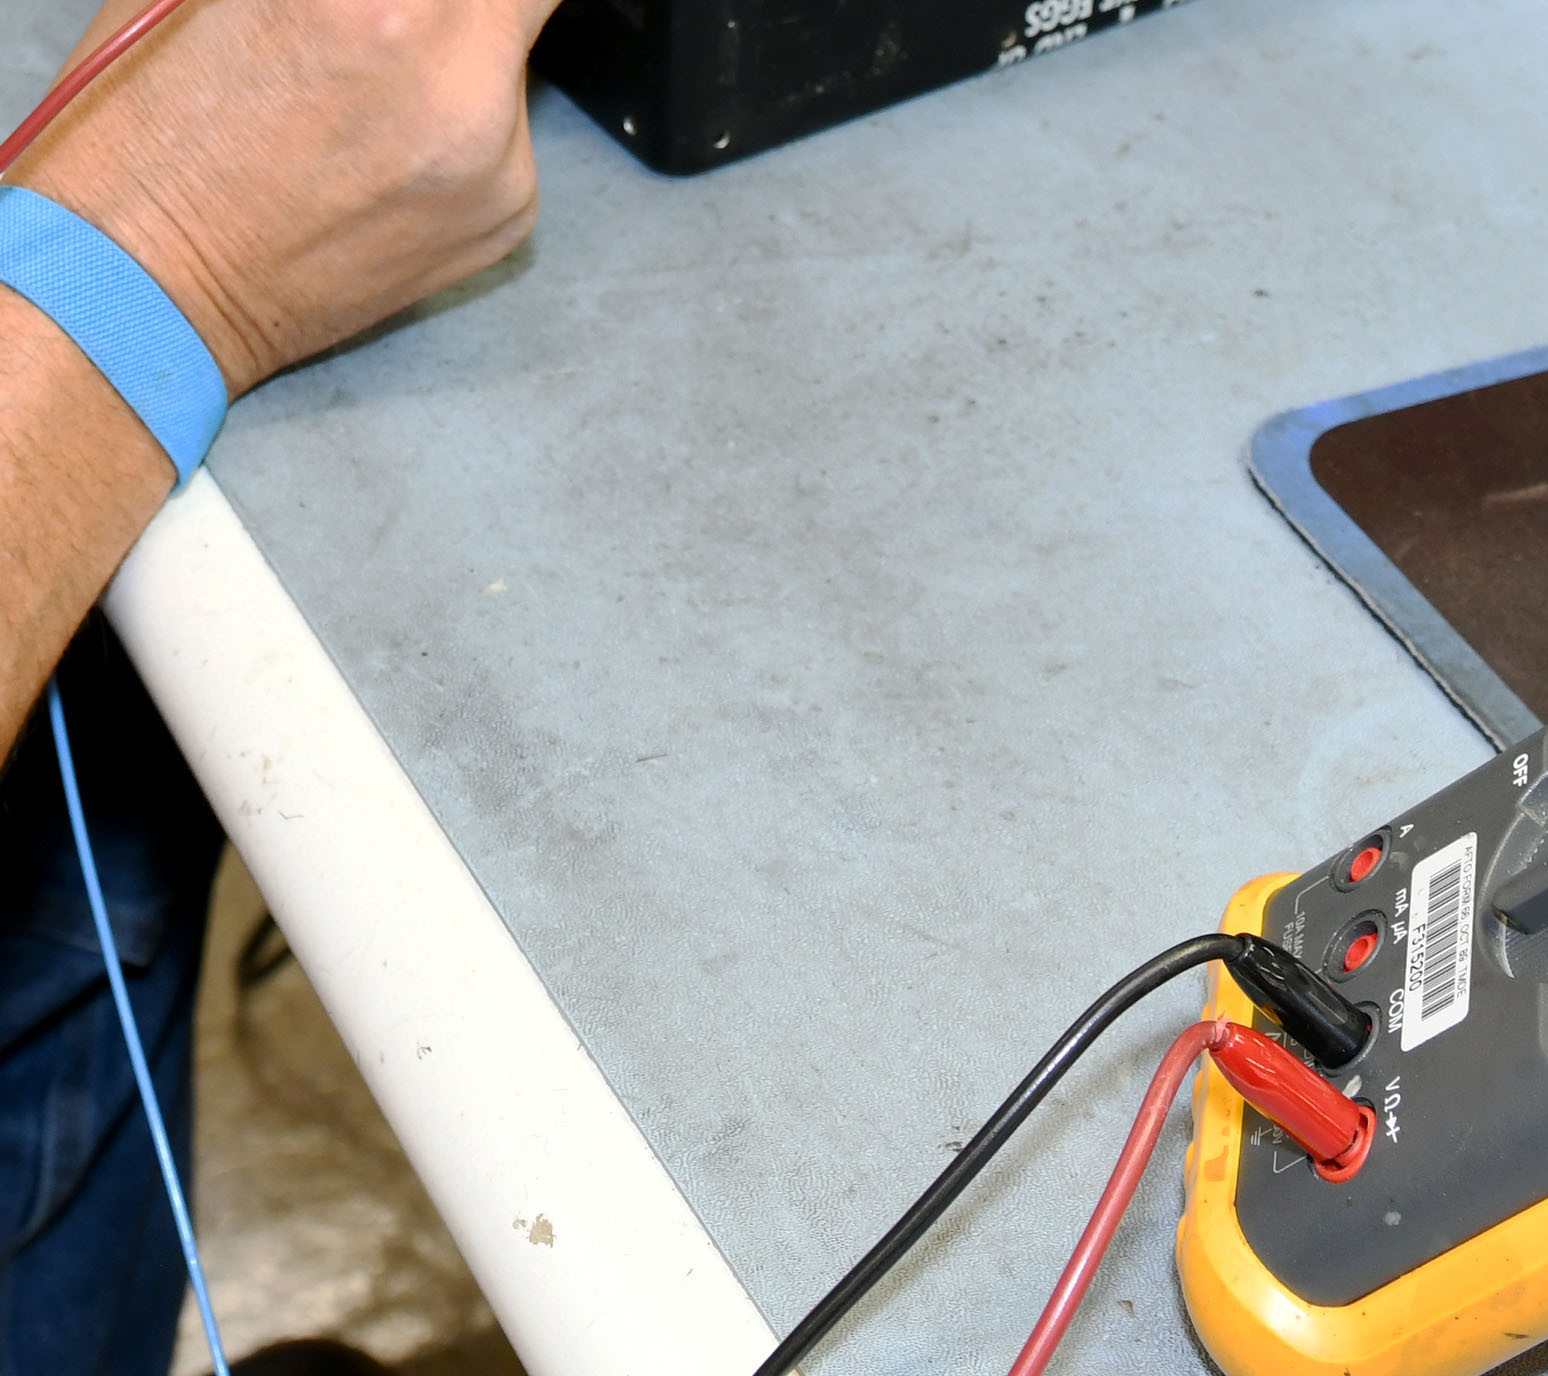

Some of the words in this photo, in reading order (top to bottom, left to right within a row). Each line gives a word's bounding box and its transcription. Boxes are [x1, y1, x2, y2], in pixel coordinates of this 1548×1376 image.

[1512, 752, 1529, 788] OFF
[1462, 846, 1474, 876] AFTO
[1460, 875, 1473, 908] FORM
[1294, 910, 1307, 935] 10A
[1459, 924, 1471, 947] OCT
[1407, 921, 1427, 993] F315200
[1456, 964, 1468, 999] TMDE
[1388, 988, 1405, 1034] COM
